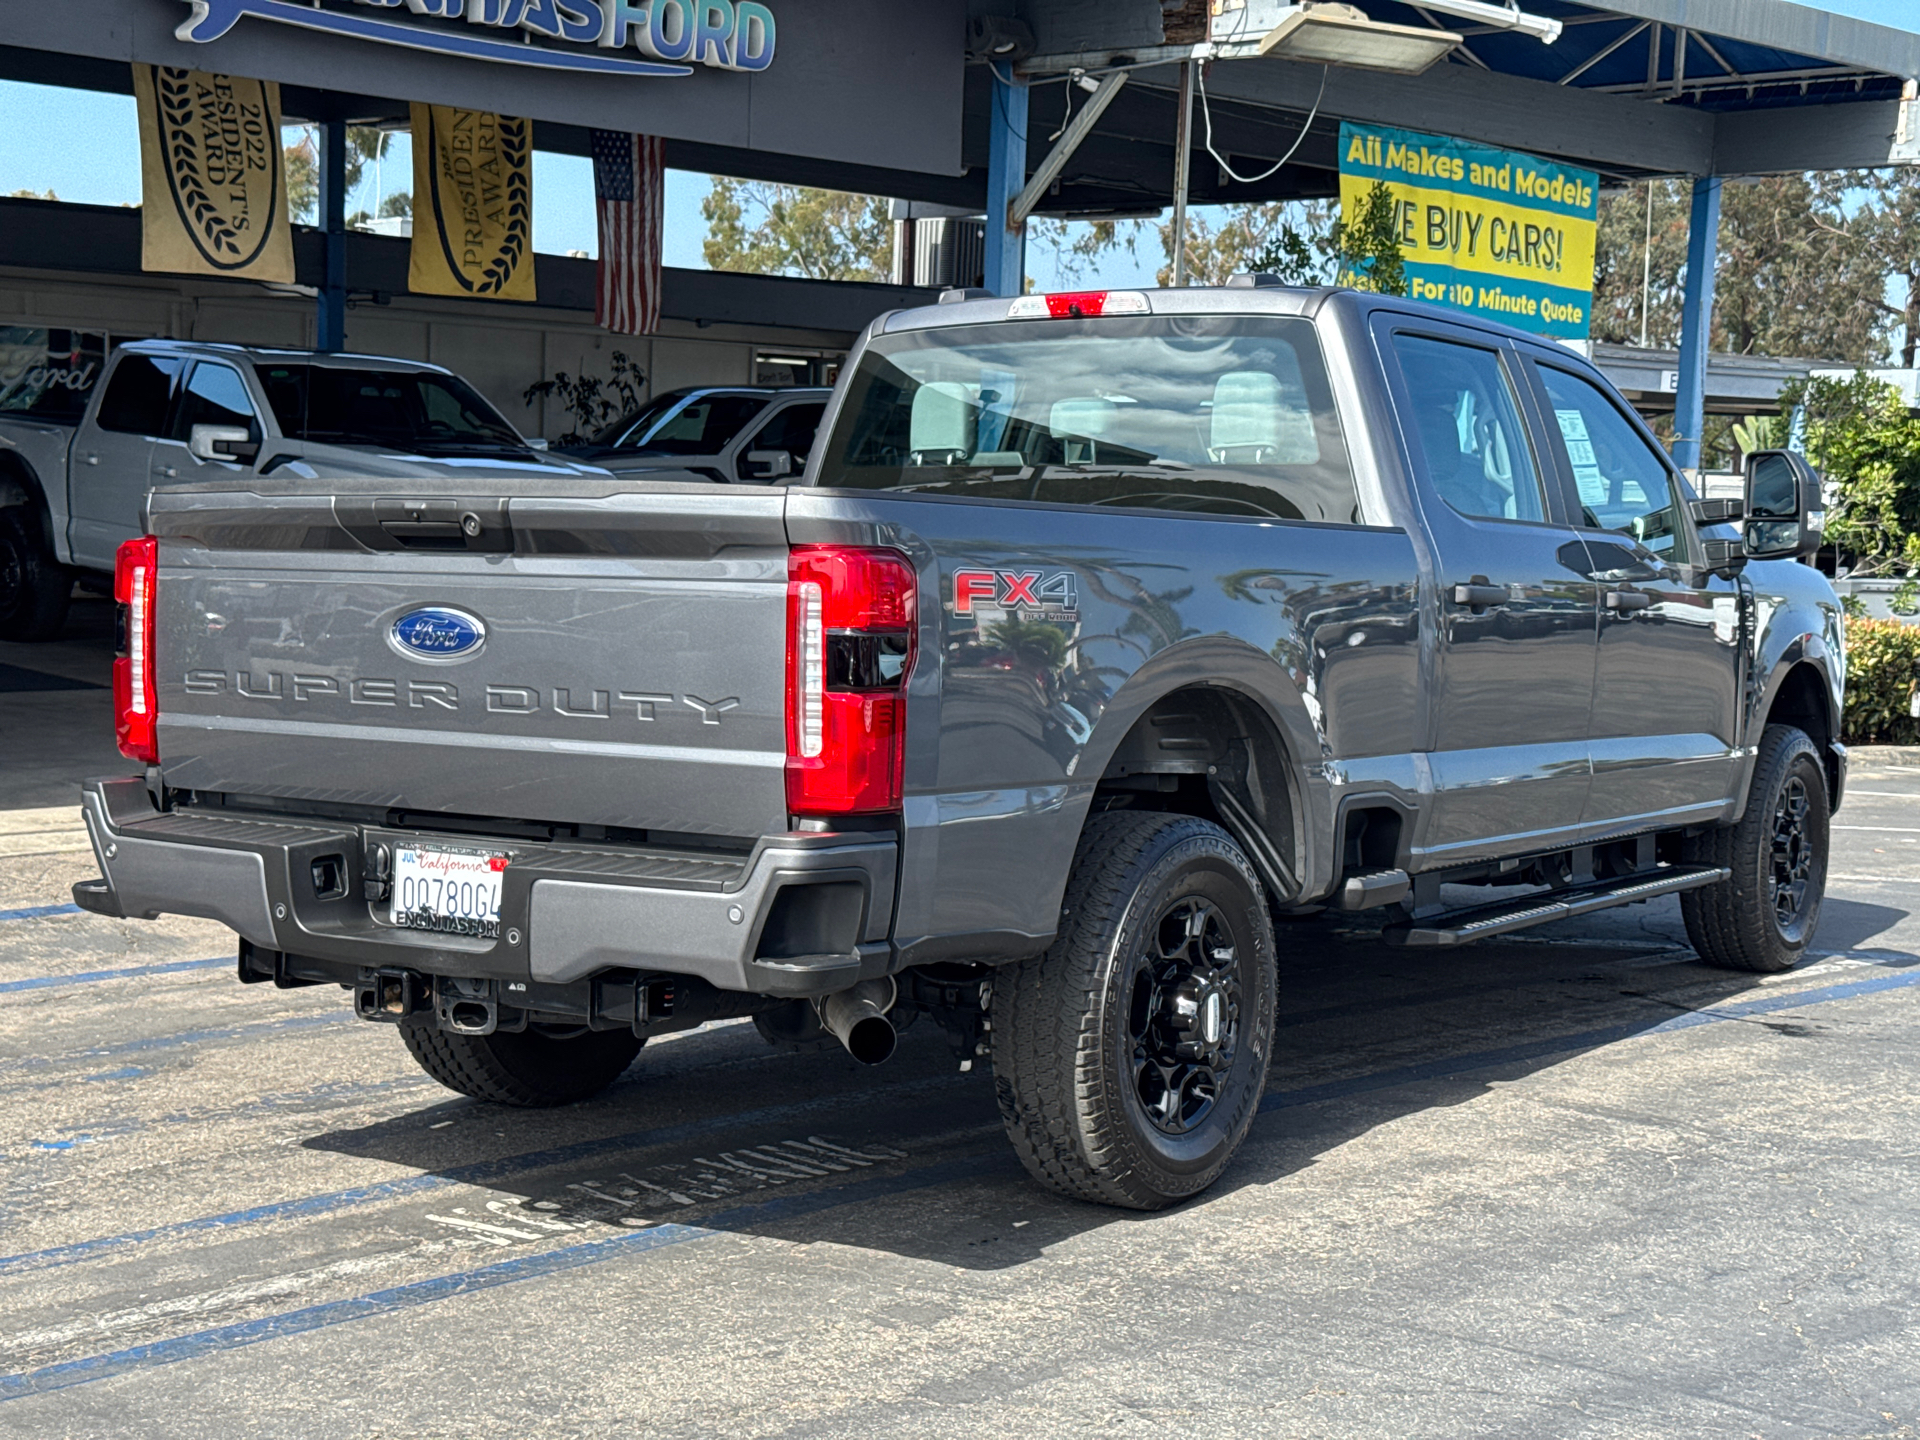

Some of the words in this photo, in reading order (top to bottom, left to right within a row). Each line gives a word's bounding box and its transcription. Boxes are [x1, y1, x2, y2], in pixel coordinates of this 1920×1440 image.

[600, 0, 777, 72] FORD
[195, 81, 227, 186] AWARD
[213, 74, 250, 231] ESIDENT'S
[240, 103, 267, 171] 2022
[453, 107, 484, 269] PRESIDEN
[479, 111, 506, 229] AWARD
[1347, 135, 1382, 167] All
[1385, 140, 1464, 182] Makes
[1470, 162, 1510, 192] and
[1515, 168, 1593, 208] Models
[1426, 205, 1484, 257] BUY
[1490, 217, 1564, 273] CARS!
[1412, 277, 1446, 300] For
[1457, 284, 1474, 307] 10
[1478, 287, 1537, 316] Minute
[1541, 297, 1583, 323] Quote
[1, 351, 96, 391] Ford
[953, 566, 1079, 619] FX4
[411, 617, 461, 648] Ford
[184, 669, 459, 711] SUPER
[486, 684, 741, 725] DUTY
[402, 851, 416, 864] JUL
[418, 851, 491, 876] California
